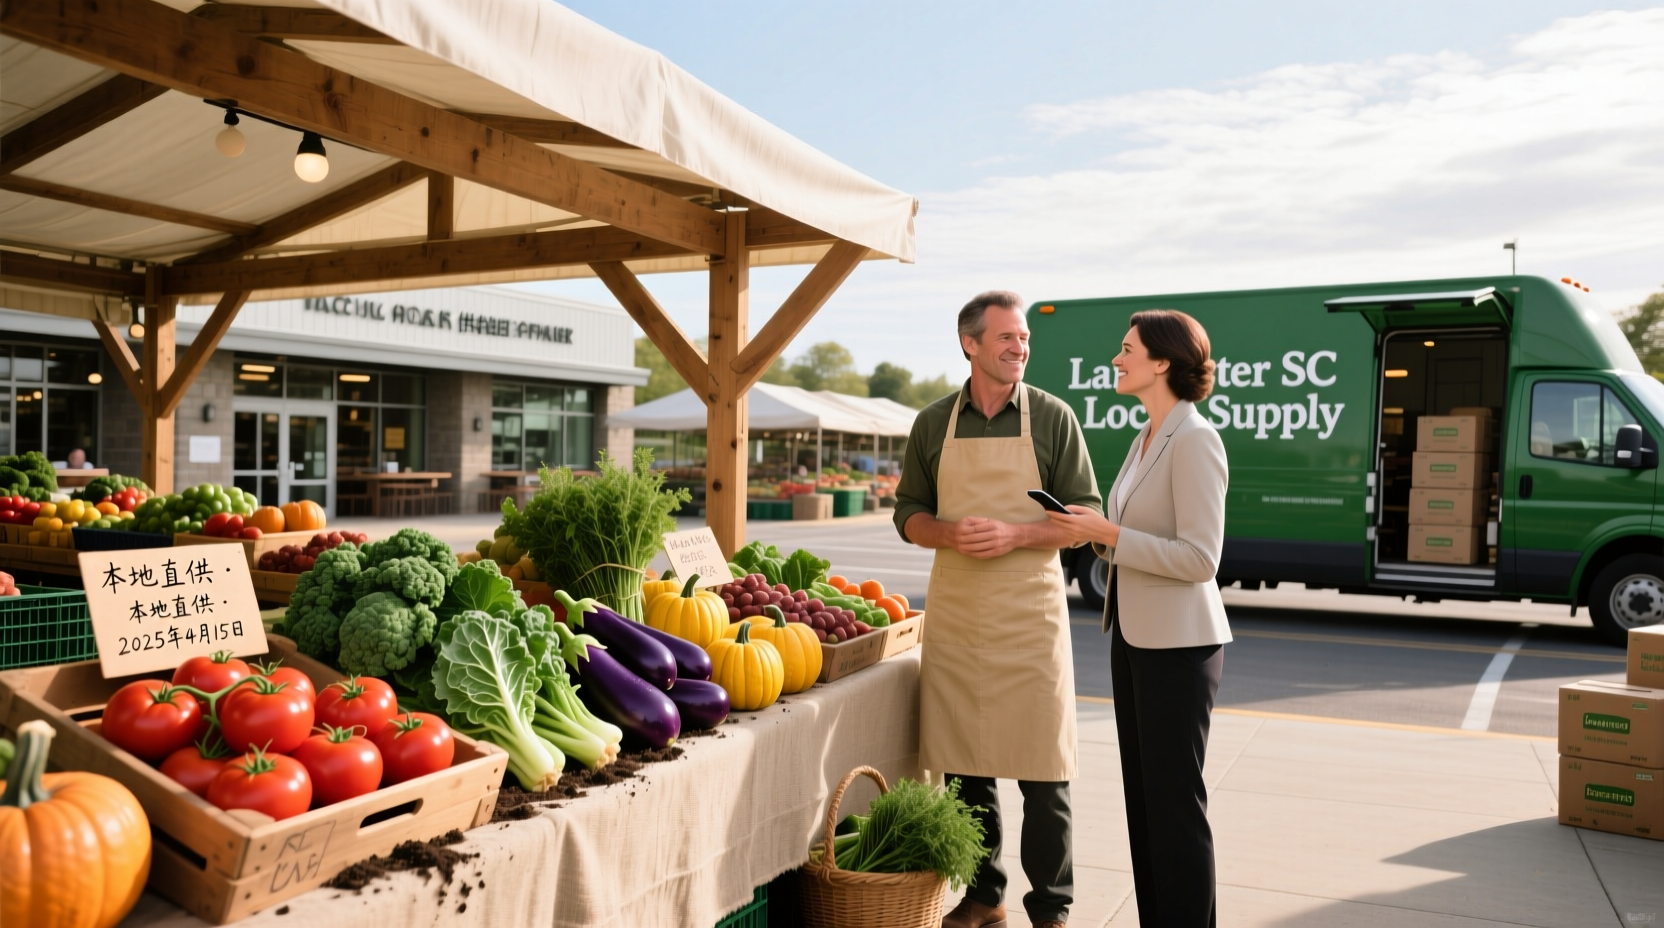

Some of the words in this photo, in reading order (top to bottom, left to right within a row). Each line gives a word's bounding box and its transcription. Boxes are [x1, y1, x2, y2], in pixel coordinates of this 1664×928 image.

[1281, 350, 1337, 387] SC
[1083, 395, 1148, 430] Loc
[1208, 393, 1346, 440] Supply
[119, 620, 244, 655] 2025年4月15日
